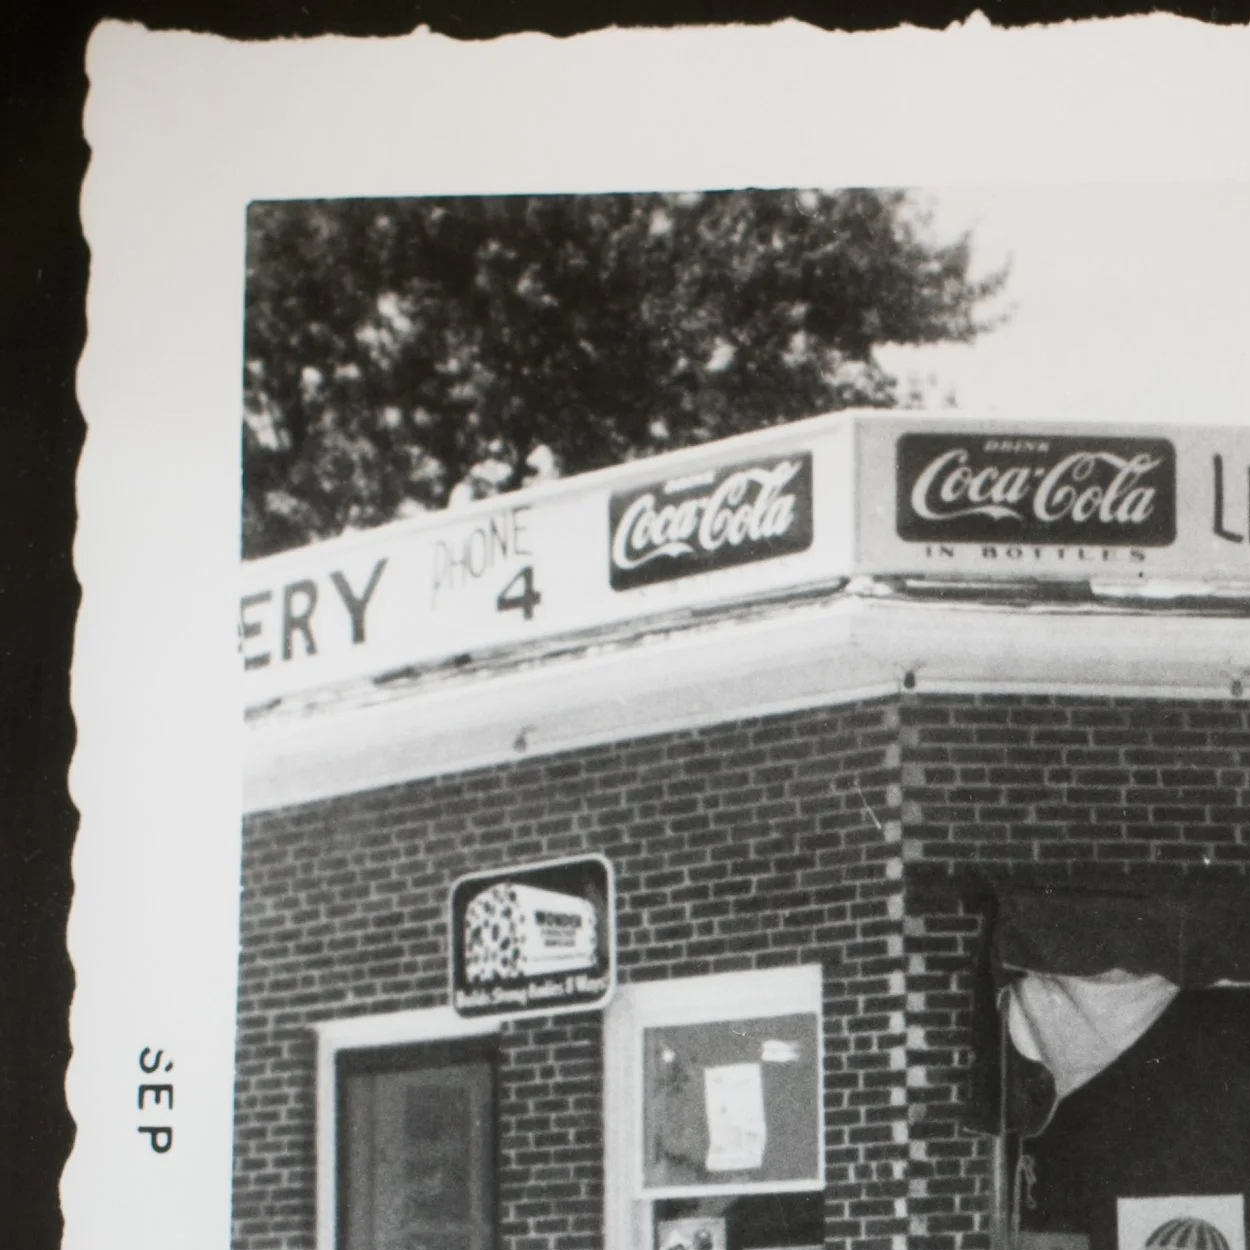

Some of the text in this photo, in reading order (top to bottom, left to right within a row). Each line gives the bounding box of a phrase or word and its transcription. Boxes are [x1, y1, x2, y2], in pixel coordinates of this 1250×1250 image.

[613, 460, 804, 570] Coca-Cola
[911, 447, 1165, 523] Coca-Cola
[430, 504, 534, 606] PHONE
[496, 563, 543, 622] 4
[982, 546, 1146, 563] BOTTLES
